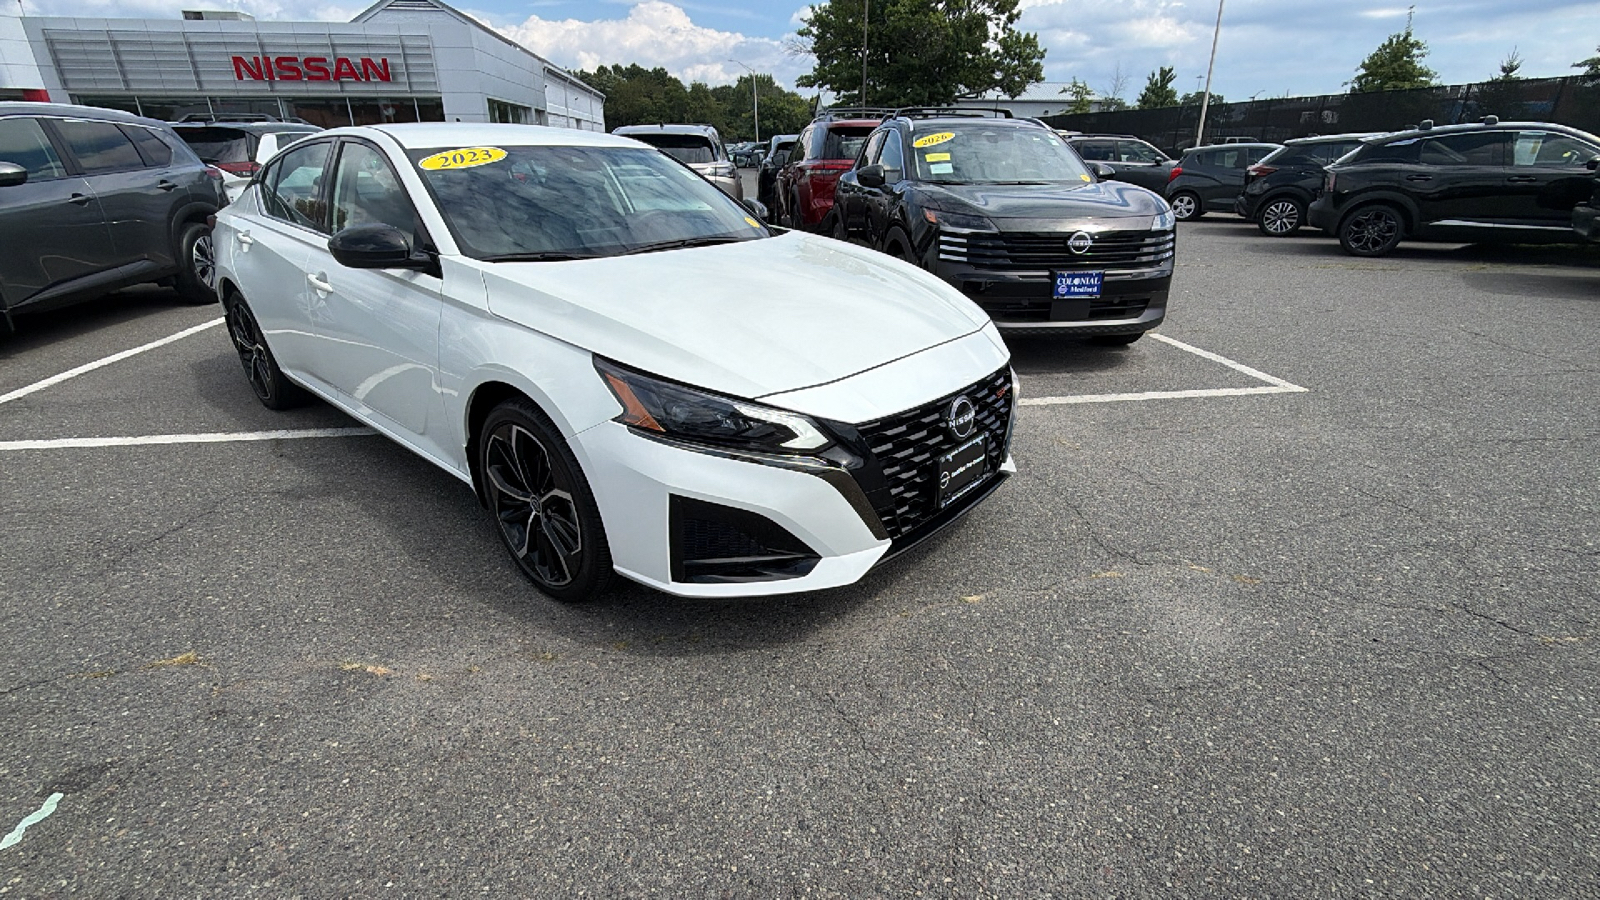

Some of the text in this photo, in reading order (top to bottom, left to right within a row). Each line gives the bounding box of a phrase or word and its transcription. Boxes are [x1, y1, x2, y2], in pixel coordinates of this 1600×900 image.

[231, 55, 392, 82] NISSAN
[922, 134, 947, 146] 2026
[438, 149, 492, 168] 2023
